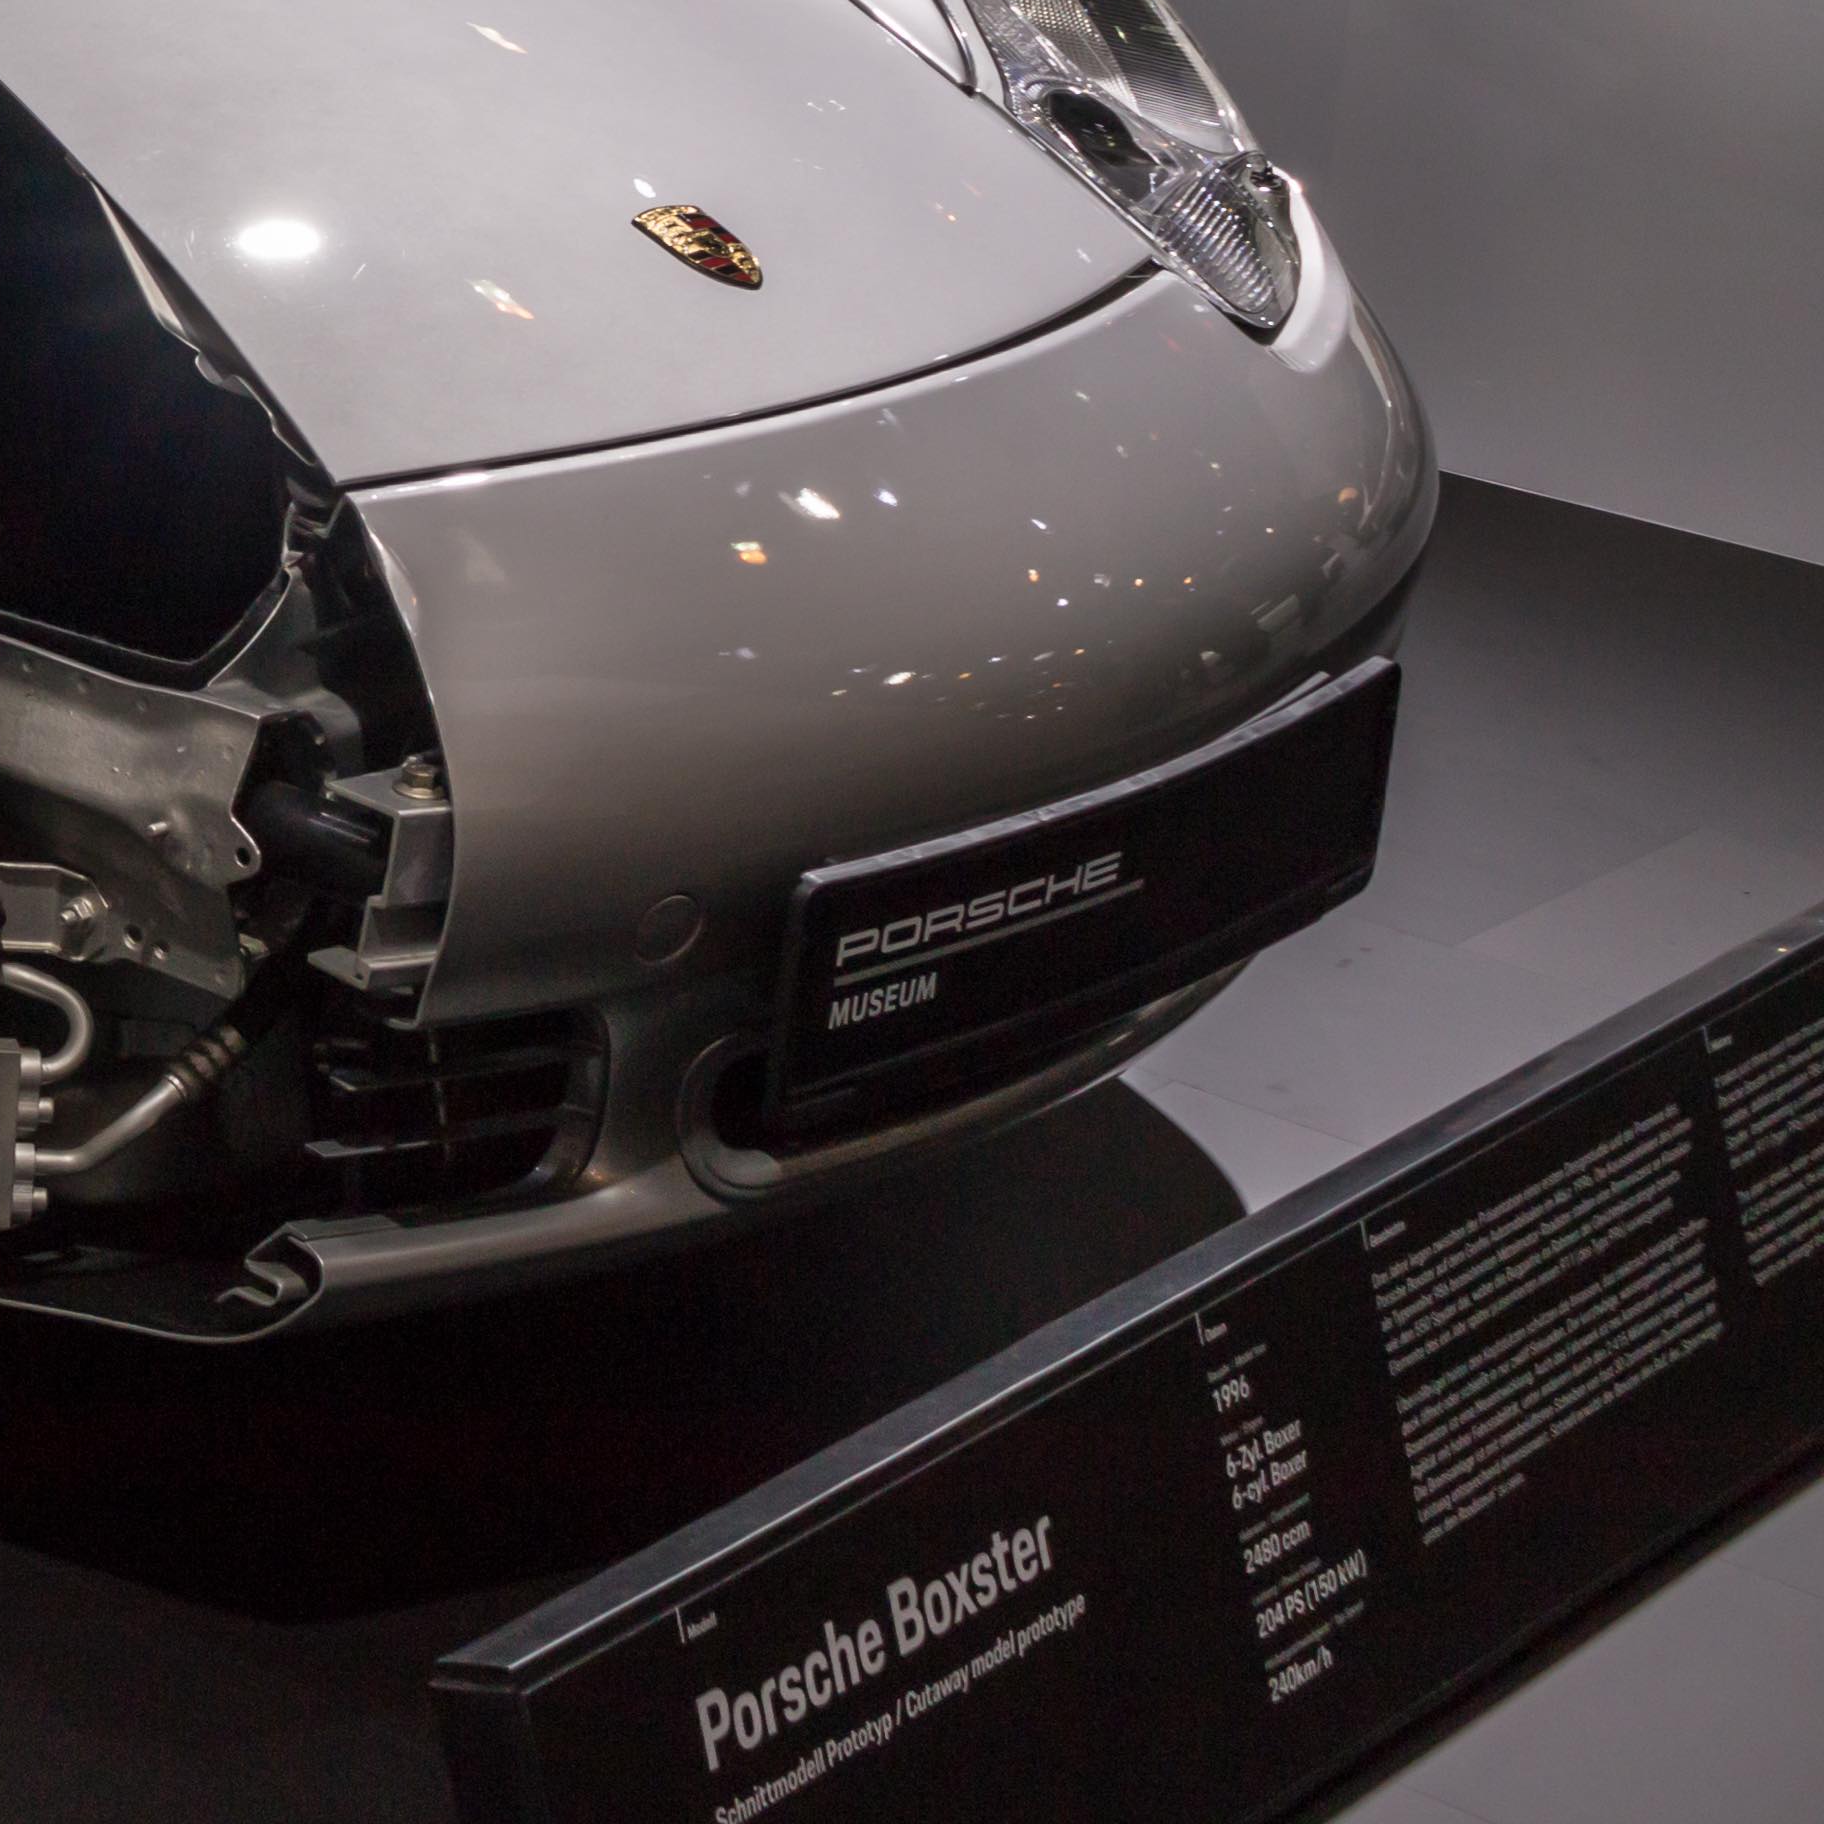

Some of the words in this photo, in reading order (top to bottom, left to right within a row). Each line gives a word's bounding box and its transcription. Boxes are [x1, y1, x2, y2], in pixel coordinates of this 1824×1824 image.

[836, 851, 1122, 966] PORSCHE
[828, 972, 938, 1030] MUSEUM
[1212, 1375, 1250, 1413] 1996
[1263, 1419, 1301, 1455] Boxer
[1270, 1450, 1307, 1487] Boxer
[1243, 1533, 1281, 1574] 2480
[1282, 1521, 1311, 1551] ccm
[1256, 1602, 1285, 1639] 204
[1285, 1589, 1305, 1620] PS
[1305, 1569, 1338, 1611] (150
[1336, 1549, 1367, 1588] kW)
[696, 1621, 885, 1772] Porsche
[887, 1515, 1053, 1656] Boxster
[715, 1749, 827, 1824] Schnittmodell
[827, 1711, 892, 1770] Prototyp
[905, 1665, 970, 1719] Cutaway
[971, 1630, 1015, 1678] model
[1017, 1593, 1085, 1656] prototype
